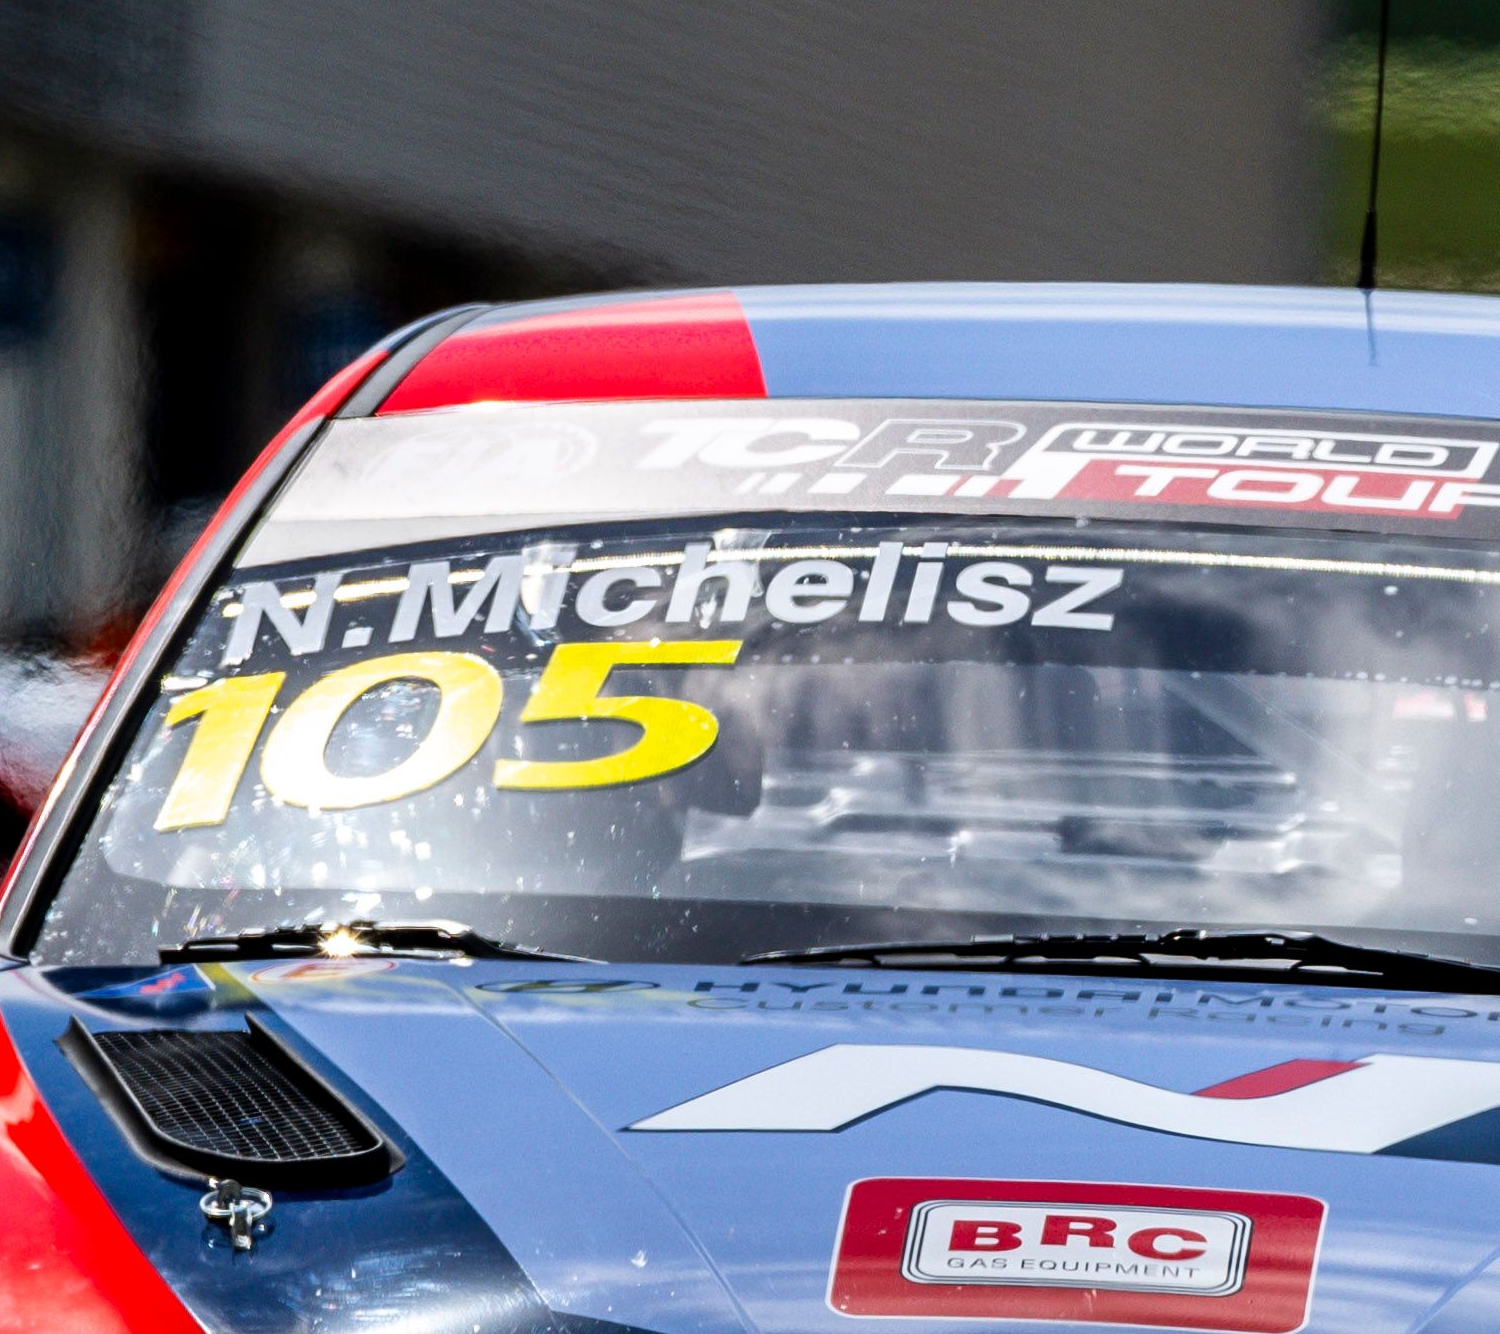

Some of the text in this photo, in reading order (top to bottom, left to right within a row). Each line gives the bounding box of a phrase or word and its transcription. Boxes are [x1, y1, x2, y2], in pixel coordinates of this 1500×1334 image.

[636, 416, 1027, 470] TCR
[1073, 429, 1451, 466] WORLD
[223, 541, 1124, 667] N.Michelisz
[155, 639, 744, 832] 105
[694, 980, 1179, 1005] HYUNDAI
[687, 997, 1446, 1037] Customer Racing
[948, 1214, 1208, 1261] BRC
[947, 1257, 1201, 1279] GAS EQUIPMENT
